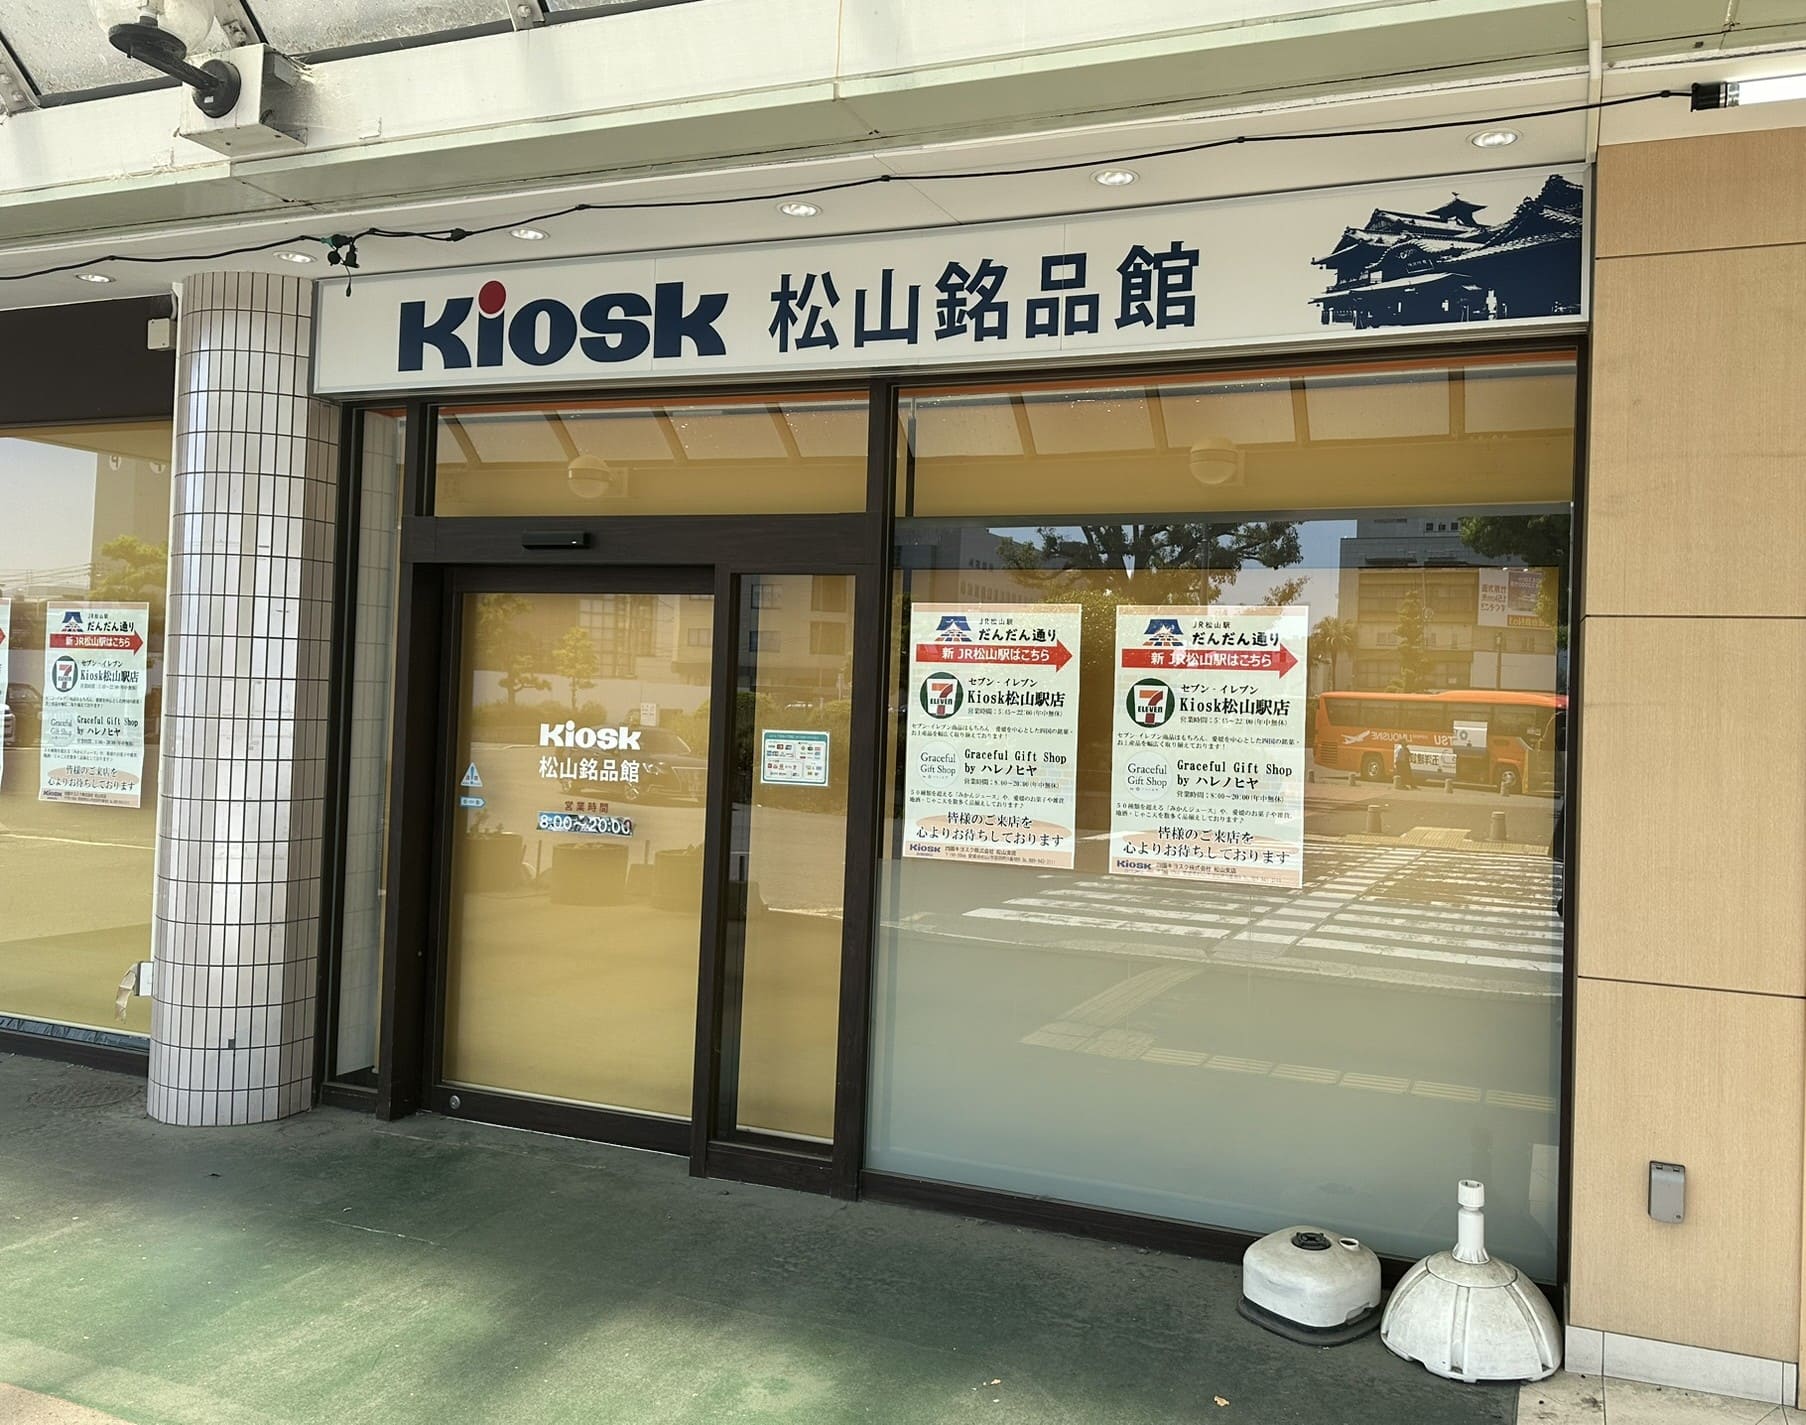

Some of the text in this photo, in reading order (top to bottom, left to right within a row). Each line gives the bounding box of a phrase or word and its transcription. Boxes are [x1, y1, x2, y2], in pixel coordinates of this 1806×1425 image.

[398, 240, 1200, 373] Kiosk 松山銘品館
[87, 621, 135, 633] だんだん通り
[1192, 621, 1231, 629] JR松山駅
[65, 636, 131, 647] 新 JR松山駅はこちら
[979, 628, 1056, 643] だんだん通り
[1192, 632, 1279, 647] だんだん通り
[942, 647, 1050, 662] 新 JR松山駅はこちら
[1151, 652, 1272, 667] 新 JR松山駅はこちら
[80, 669, 139, 684] Kiosk松山駅店
[967, 690, 1066, 708] Kiosk松山駅店
[1180, 697, 1291, 717] Kiosk松山駅店
[77, 715, 104, 725] Graceful
[107, 716, 121, 726] Gift
[87, 727, 121, 737] ハレノヒヤ
[539, 720, 641, 750] Kiosk
[920, 752, 956, 763] Graceful
[964, 749, 1067, 765] Graceful Gift Shop
[539, 756, 639, 783] 松山銘品館
[920, 764, 956, 776] Gift Shop
[964, 762, 1038, 777] by ハレノヒヤ
[1127, 763, 1167, 775] Graceful
[1177, 759, 1293, 777] Graceful Gift Shop
[48, 777, 135, 791] 心よりお待ちしております
[1127, 776, 1168, 789] Gift Shop
[1177, 774, 1259, 790] by ハレノヒヤ
[564, 801, 609, 814] 営業時間
[948, 811, 1032, 829] 皆様のご来店を
[916, 827, 1064, 847] 心よりお待ちしております
[1158, 826, 1254, 845] 皆様のご来店を
[1123, 842, 1291, 864] 心よりお待ちしております
[1117, 860, 1152, 870] Kiosk
